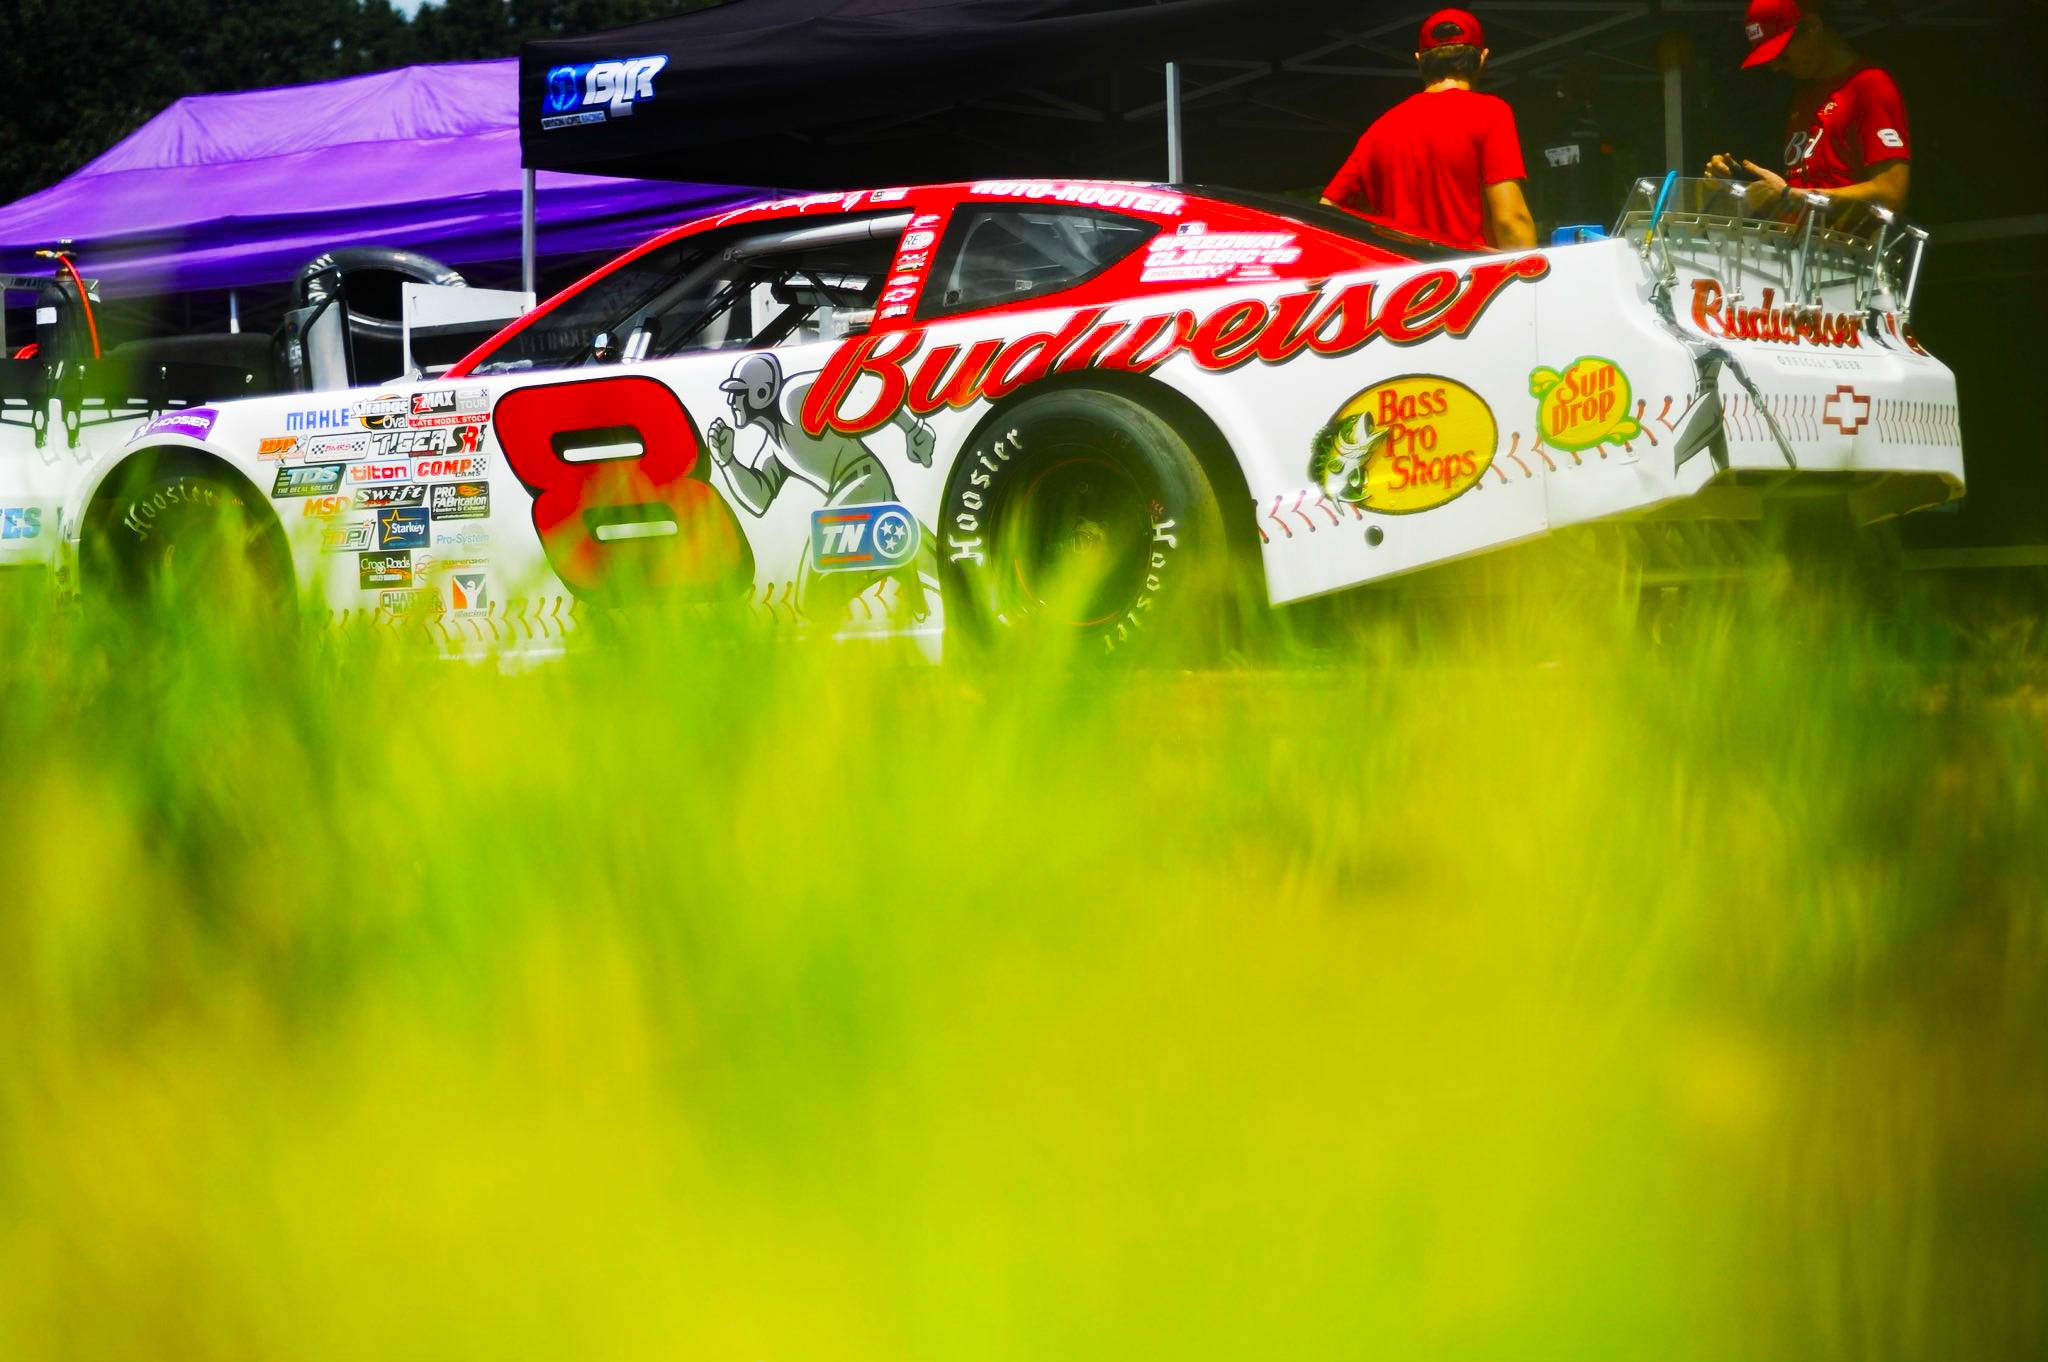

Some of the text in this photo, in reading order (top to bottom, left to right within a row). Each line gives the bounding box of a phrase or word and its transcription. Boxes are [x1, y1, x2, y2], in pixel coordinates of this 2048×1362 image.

[1877, 128, 1904, 147] 8
[1149, 234, 1297, 251] SPEEDWAY
[1144, 249, 1260, 267] CLASSIC
[802, 254, 1550, 438] Budweiser
[1556, 365, 1615, 403] Sun
[286, 408, 350, 431] MAHLE
[1376, 387, 1448, 427] Bass
[1552, 390, 1616, 437] Drop
[382, 415, 408, 429] Oval
[412, 414, 488, 427] LATE MODEL STOCK
[372, 429, 448, 456] TIGER
[1384, 422, 1438, 458] Pro
[351, 464, 407, 481] tilton
[416, 459, 473, 478] COMP
[1387, 449, 1478, 492] Shops
[434, 486, 456, 499] PRO
[493, 375, 756, 606] 8
[949, 428, 1023, 567] Hoosier
[303, 495, 352, 517] MSD
[0, 507, 42, 539] ES
[391, 522, 425, 535] Starkey
[822, 523, 866, 555] TN
